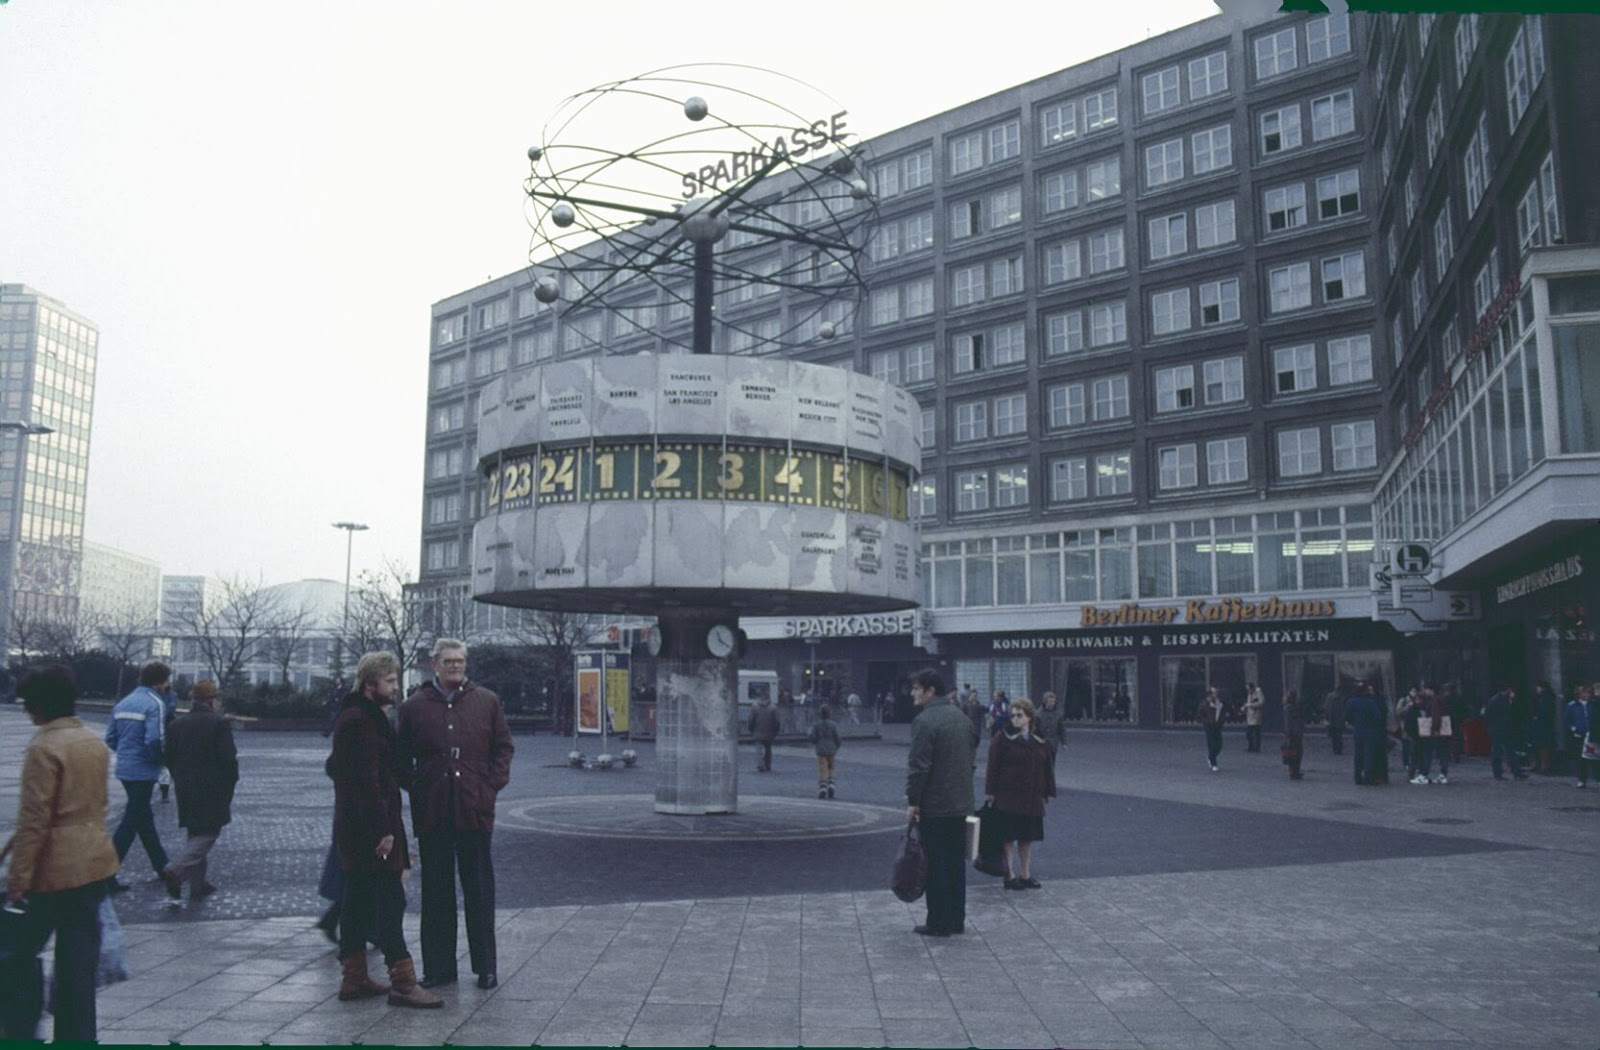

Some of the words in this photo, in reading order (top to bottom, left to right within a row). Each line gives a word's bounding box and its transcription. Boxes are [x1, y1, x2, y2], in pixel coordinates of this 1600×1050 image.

[682, 110, 850, 199] SPARKASSE
[670, 374, 712, 382] VANCOUVER
[741, 384, 776, 393] EDMONTON
[745, 393, 771, 401] DENVER
[502, 462, 532, 500] 23
[541, 455, 576, 494] 24
[596, 453, 615, 489] 1
[651, 451, 682, 488] 2
[717, 452, 744, 490] 3
[773, 457, 803, 493] 4
[832, 463, 851, 499] 5
[1080, 602, 1178, 627] Berliner
[1185, 594, 1335, 623] Kaffeehaus
[783, 614, 914, 637] SPARKASSE
[992, 635, 1134, 650] KONDITOREIWAREN
[1142, 636, 1152, 646] &
[1162, 628, 1330, 646] EISSPEZIALITÄTEN
